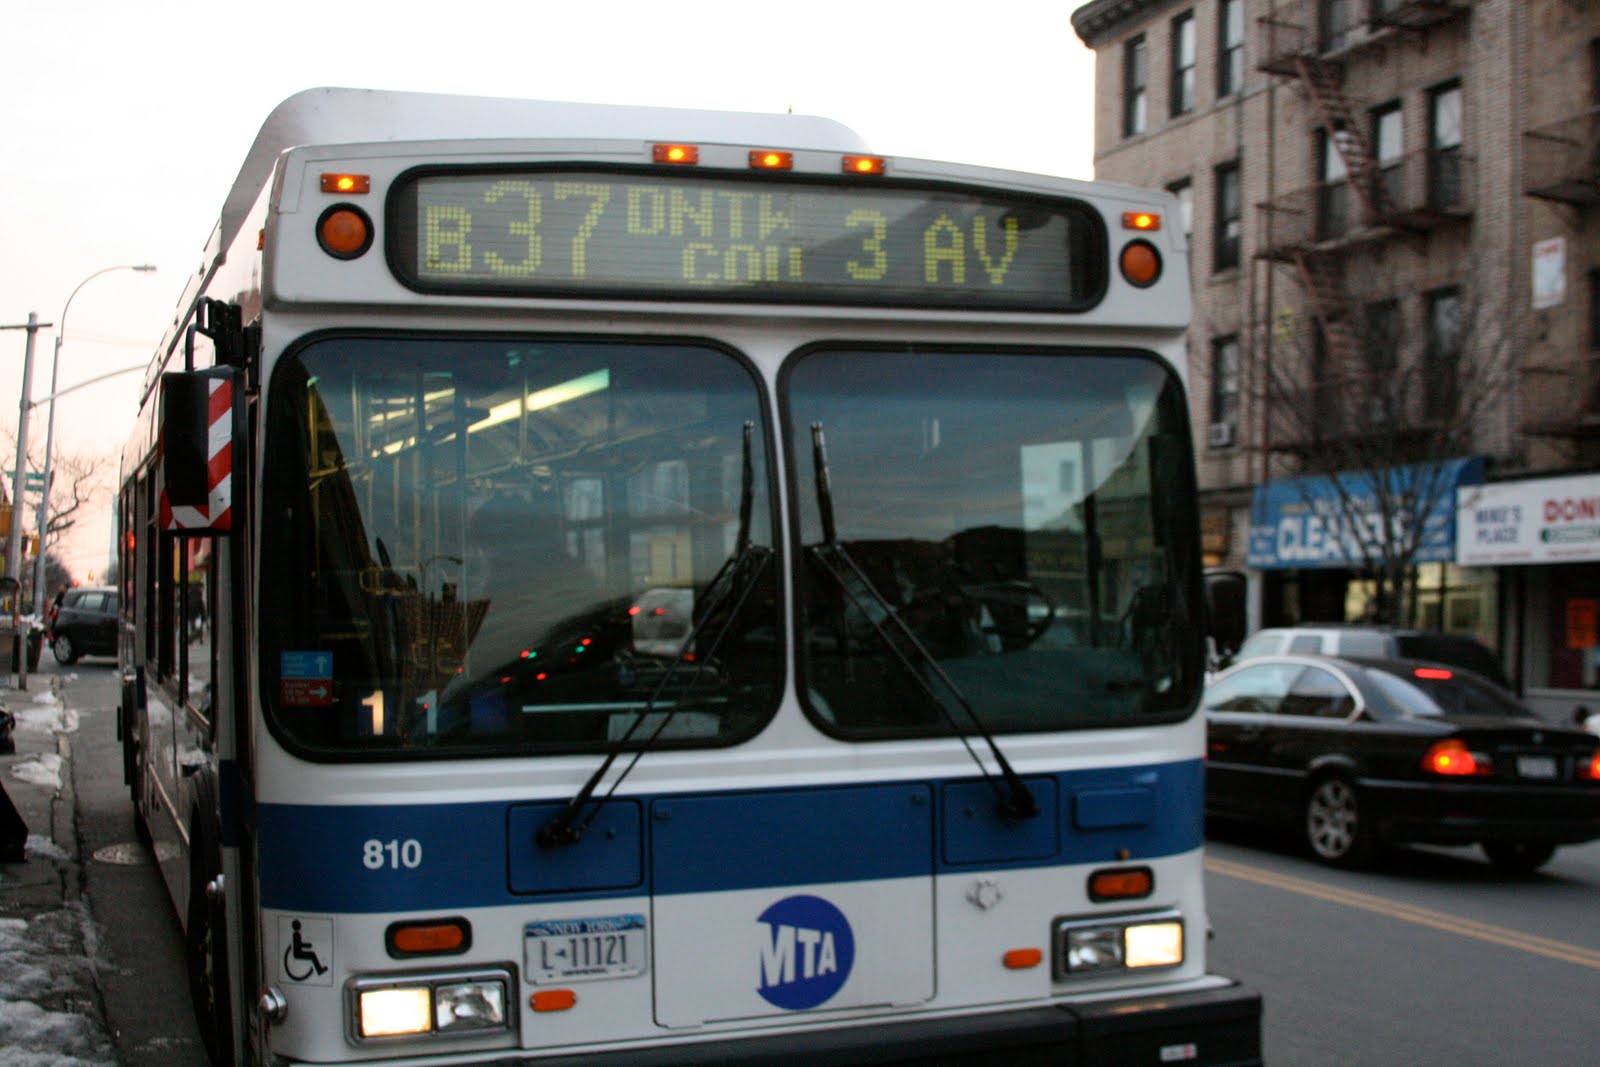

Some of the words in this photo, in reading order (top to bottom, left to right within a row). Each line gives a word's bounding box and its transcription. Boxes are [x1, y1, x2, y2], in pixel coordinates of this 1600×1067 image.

[425, 180, 611, 278] B37
[846, 209, 888, 281] 3
[924, 213, 1019, 285] AV
[1543, 496, 1600, 524] DON
[363, 839, 422, 869] 810
[757, 921, 837, 988] MTA
